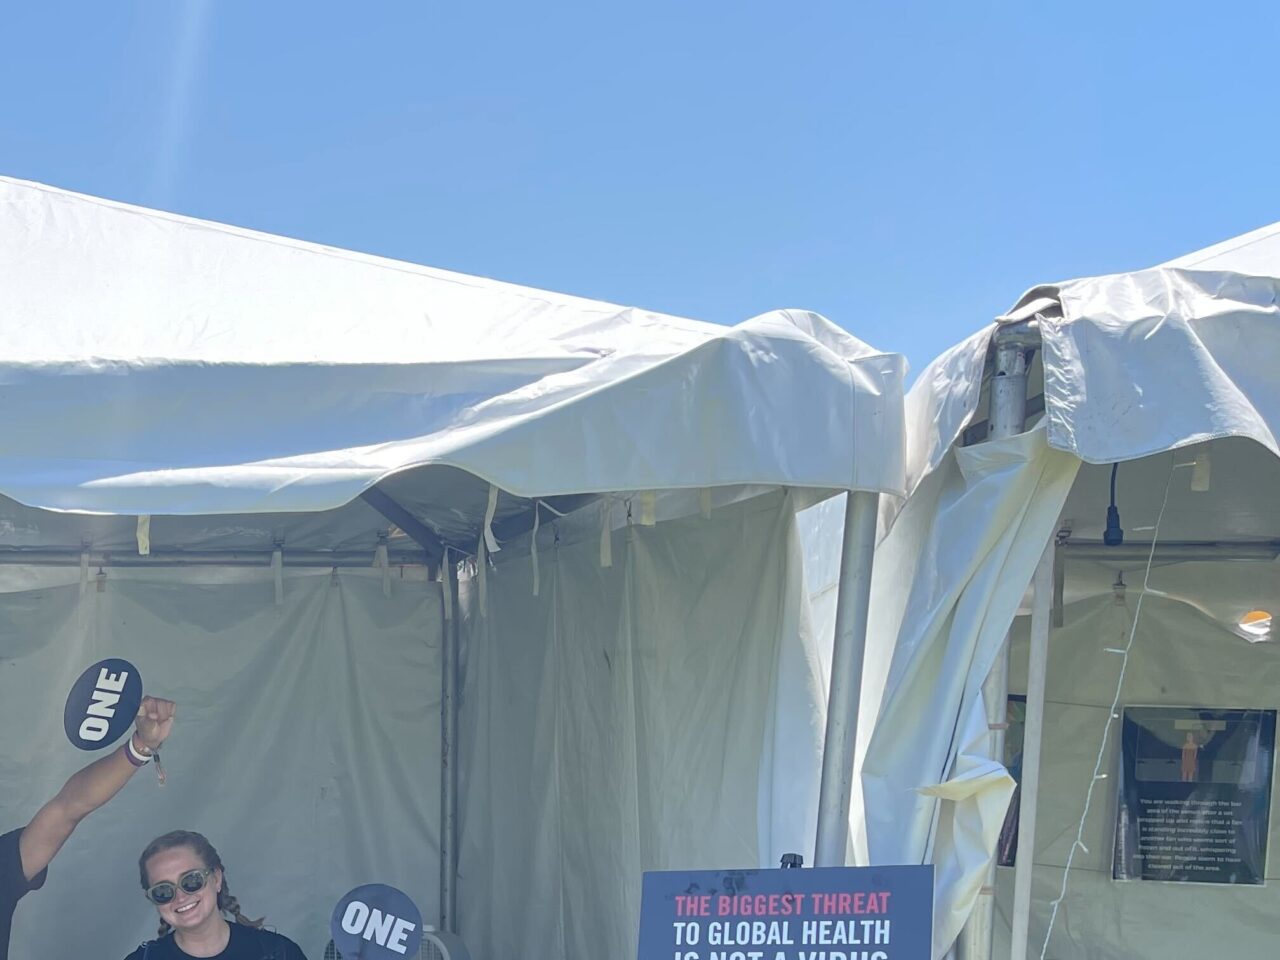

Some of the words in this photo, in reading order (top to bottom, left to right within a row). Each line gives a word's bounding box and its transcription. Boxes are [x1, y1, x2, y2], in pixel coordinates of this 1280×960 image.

[79, 667, 128, 742] ONE
[675, 895, 710, 917] THE
[719, 893, 805, 916] BIGGEST
[812, 891, 891, 914] THREAT
[341, 901, 416, 955] ONE
[673, 922, 699, 946] TO
[708, 921, 794, 945] GLOBAL
[802, 920, 891, 945] HEALTH
